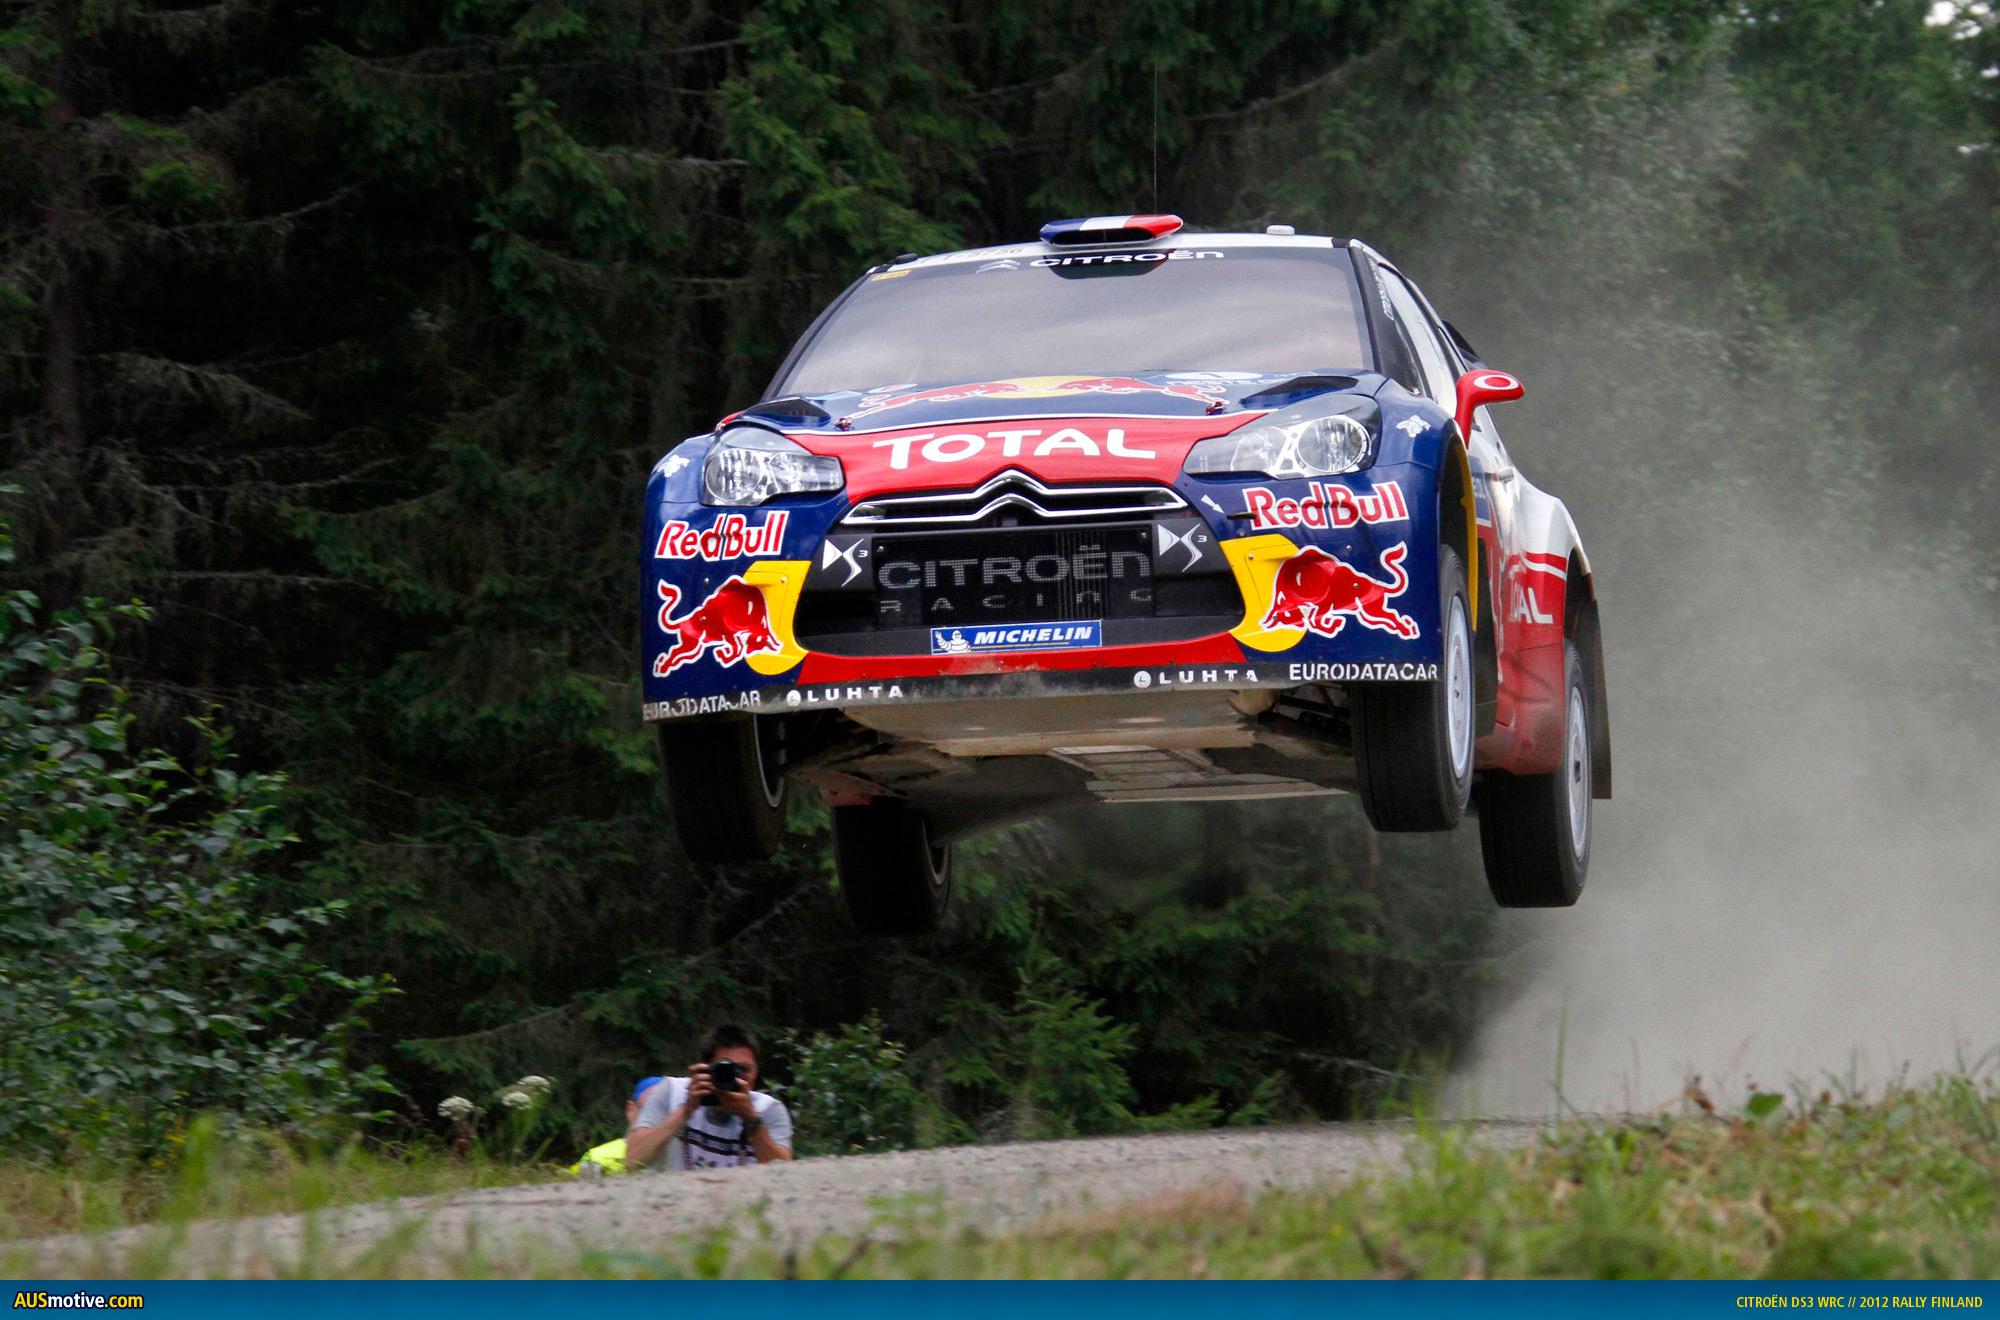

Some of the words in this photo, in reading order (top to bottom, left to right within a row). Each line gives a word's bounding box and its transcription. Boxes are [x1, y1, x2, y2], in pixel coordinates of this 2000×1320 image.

[872, 428, 1156, 470] TOTAL
[974, 626, 1092, 645] MICHELIN
[1159, 669, 1259, 684] LUHTA
[1289, 663, 1438, 681] EURODATACAR
[807, 685, 904, 703] LUHTA
